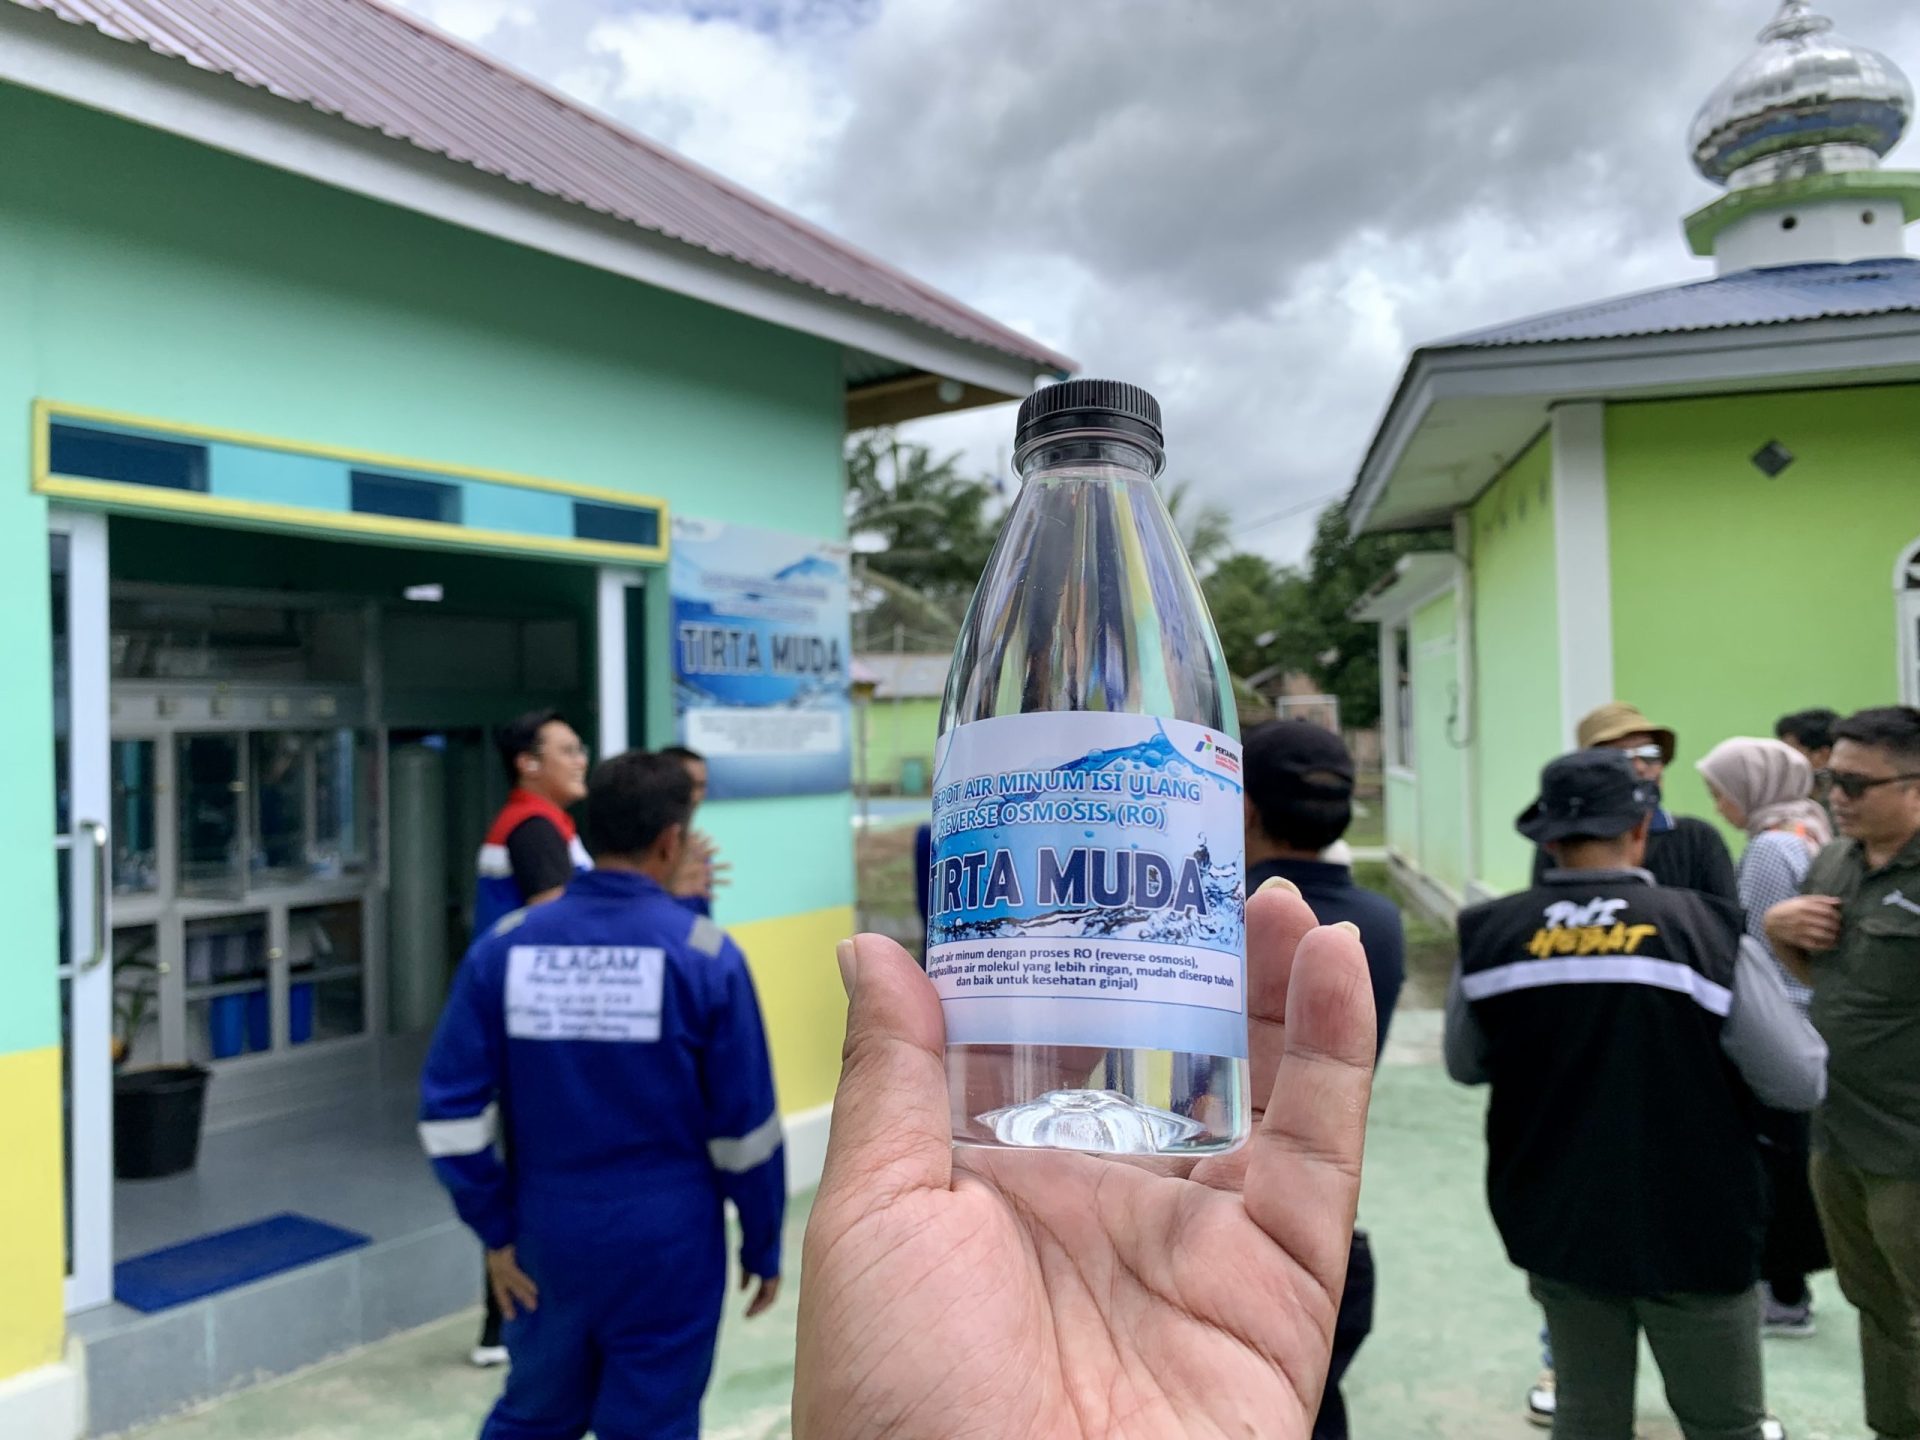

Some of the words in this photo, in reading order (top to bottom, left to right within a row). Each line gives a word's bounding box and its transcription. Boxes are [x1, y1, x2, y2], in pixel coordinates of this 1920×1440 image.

[682, 626, 762, 671] TIRTA
[771, 630, 843, 675] MUDA
[933, 784, 961, 812] DEPOT
[964, 777, 993, 799] AIR
[998, 770, 1085, 794] MINUM
[1091, 771, 1122, 792] ISI
[1129, 774, 1200, 802] ULANG
[939, 804, 998, 837] REVERSE
[1002, 801, 1109, 825] OSMOSIS
[1117, 803, 1166, 831] (RO)
[929, 848, 1023, 918] TIRTA
[1037, 848, 1209, 916] MUDA
[945, 950, 954, 962] air
[955, 949, 985, 961] minum
[986, 948, 1026, 960] dengan
[1029, 949, 1070, 960] proses
[1073, 948, 1092, 959] RO
[1095, 948, 1146, 962] (reverse
[1149, 953, 1198, 969] osmosis),
[964, 962, 976, 973] air
[977, 960, 1020, 973] molekul
[1022, 962, 1051, 974] yang
[1054, 961, 1086, 973] lebih
[1089, 963, 1133, 977] ringan,
[1136, 966, 1177, 979] mudah
[1178, 969, 1213, 985] diserap
[1214, 974, 1234, 988] tubuh
[956, 975, 972, 987] dan
[973, 974, 994, 986] baik
[996, 974, 1029, 985] untuk
[1032, 974, 1096, 987] kesehatan
[1099, 976, 1139, 991] ginjal)
